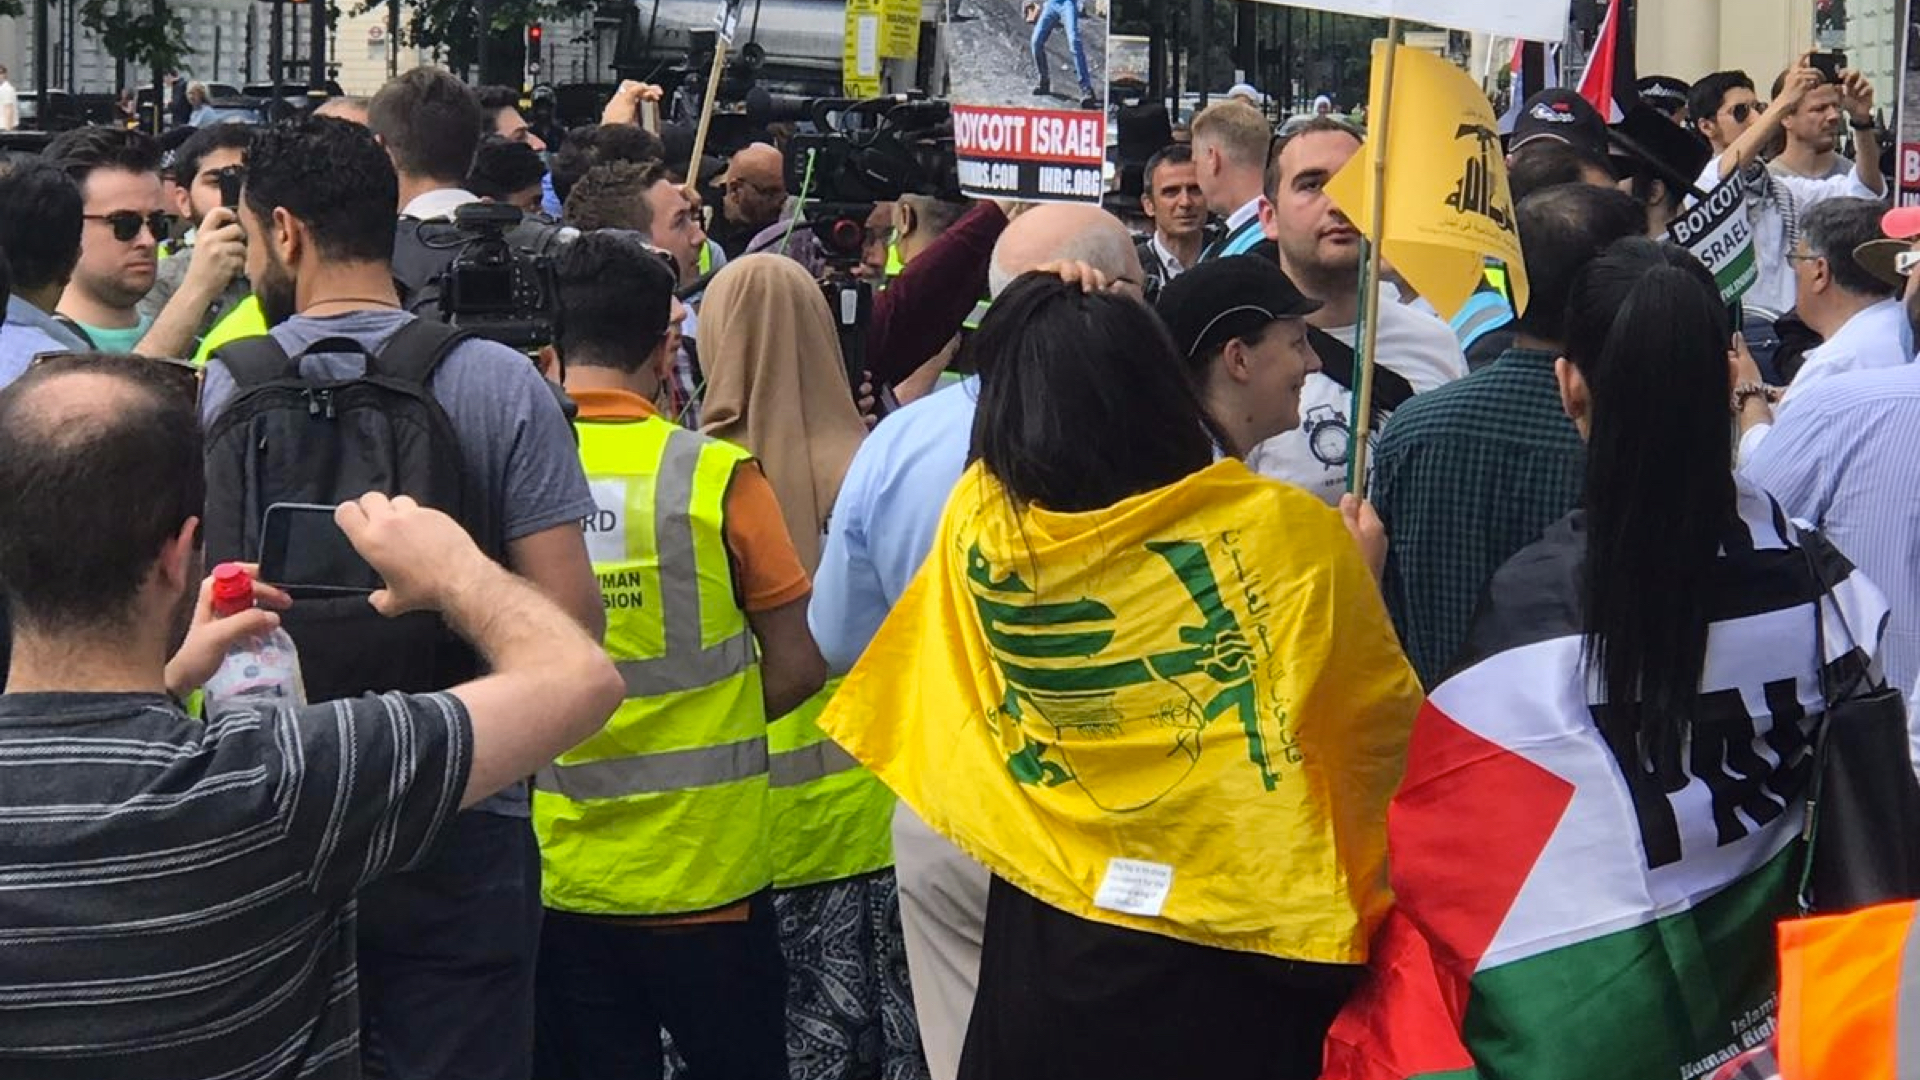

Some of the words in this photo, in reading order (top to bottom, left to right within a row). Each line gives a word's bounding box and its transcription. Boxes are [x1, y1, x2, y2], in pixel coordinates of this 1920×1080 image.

[1031, 116, 1101, 158] ISRAEL
[1673, 170, 1744, 244] BOYCOTT
[1701, 219, 1750, 269] SRAEL
[580, 510, 617, 533] RD
[598, 571, 641, 589] MAN
[1730, 990, 1778, 1036] Islami
[1680, 1042, 1742, 1080] Human
[1740, 1015, 1778, 1049] Righ
